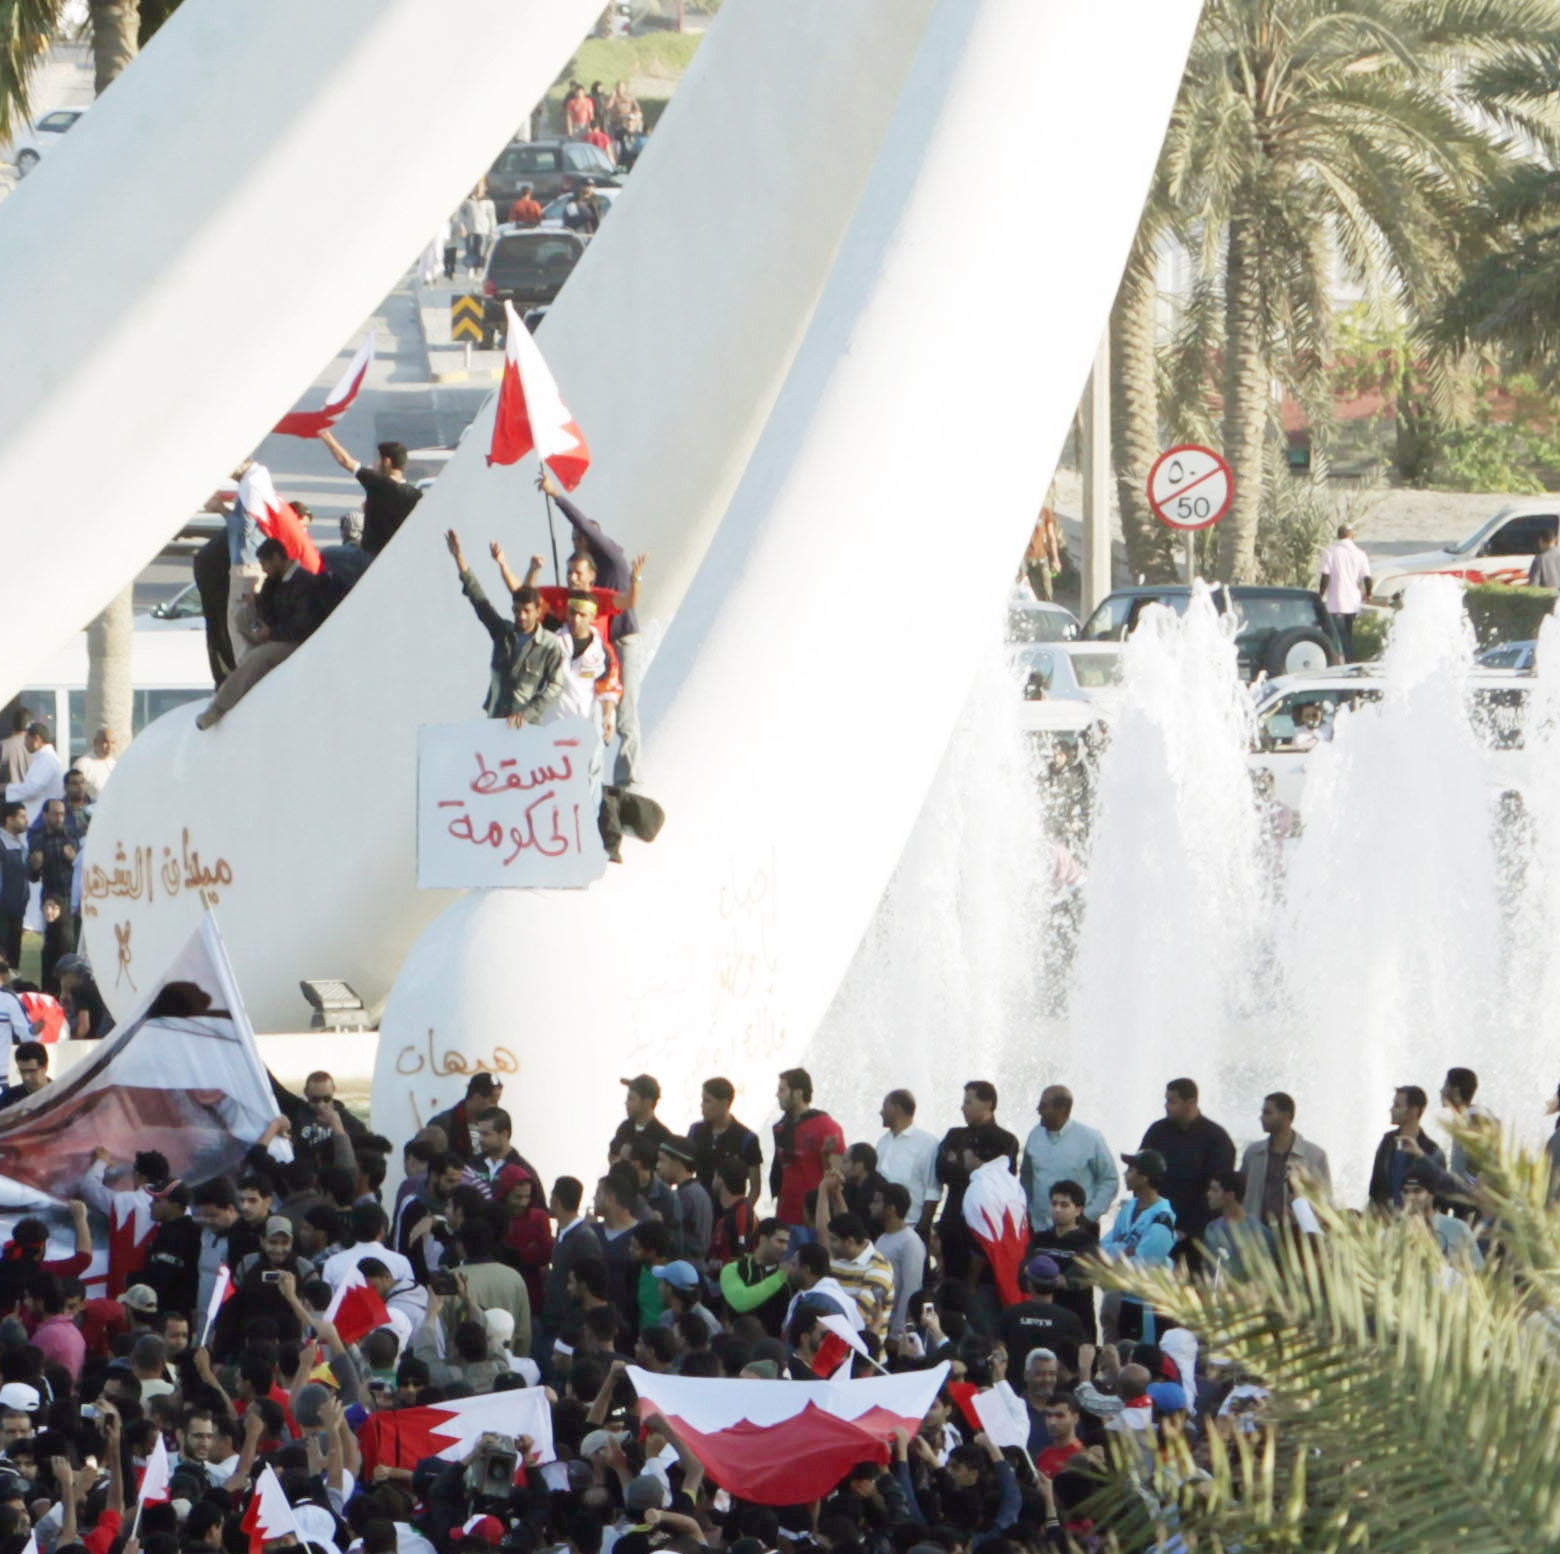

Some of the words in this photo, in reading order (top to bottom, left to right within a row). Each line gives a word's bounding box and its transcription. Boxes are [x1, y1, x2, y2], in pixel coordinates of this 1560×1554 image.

[1168, 460, 1197, 484] ٥٠
[1177, 497, 1210, 519] 50
[470, 737, 579, 796] تسقط
[437, 798, 583, 866] الحكومة
[161, 825, 233, 905] ميدان
[396, 1028, 519, 1077] هيهات
